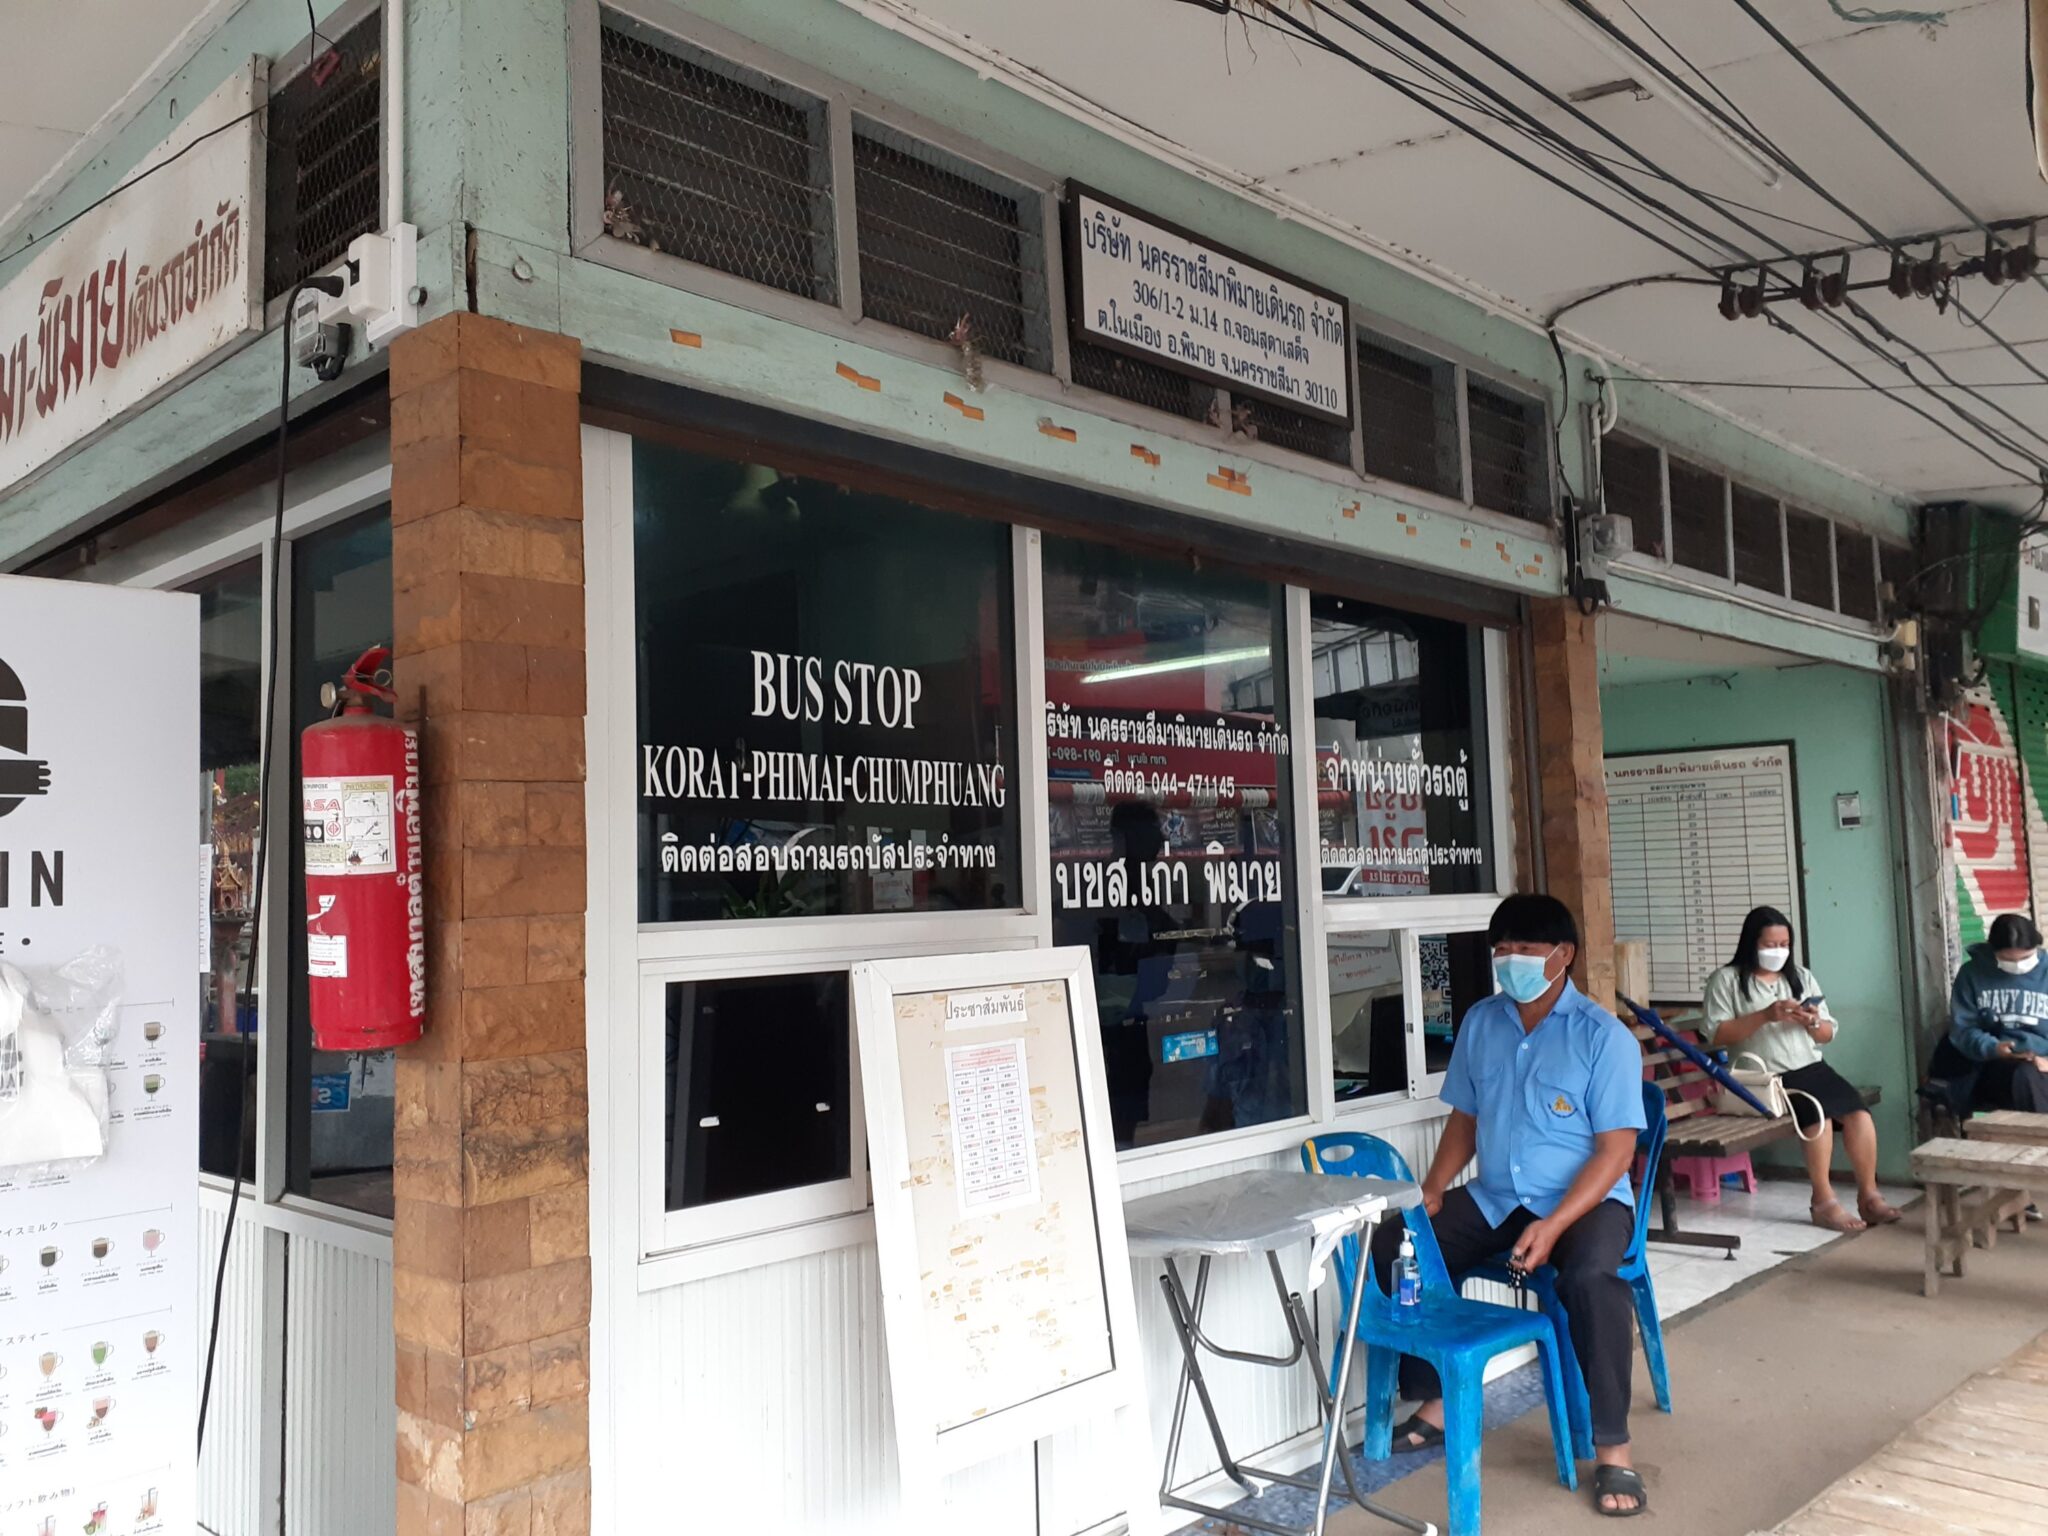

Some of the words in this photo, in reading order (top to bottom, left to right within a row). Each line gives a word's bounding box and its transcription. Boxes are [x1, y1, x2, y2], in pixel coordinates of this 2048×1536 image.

[1084, 211, 1132, 262] บริษัท
[1139, 240, 1305, 332] นครราชสีมาพิมายเดินรถ
[1311, 302, 1344, 346] จำกัด
[1132, 280, 1184, 320] 306/1-2
[1190, 304, 1218, 332] ม.14
[1098, 300, 1162, 348] ต.ในเมือง
[1168, 328, 1216, 368] อ.พิมาย
[1221, 352, 1300, 397] จ.นครราชสีมา
[1304, 380, 1338, 409] 30110
[751, 650, 824, 723] BUS
[834, 659, 922, 729] STOP
[1045, 700, 1082, 740] ริษัท
[1088, 710, 1254, 752] นครราชสีมาพิมายเดินรถ
[1257, 723, 1289, 755] จำกัด
[1104, 758, 1145, 794] ติดต่อ
[1152, 773, 1235, 798] 044-471145
[1326, 735, 1469, 810] จำหน่ายตั๋วรถตู้
[661, 833, 996, 873] ติดต่อสอบถามรถบัสประจำทาง
[1055, 841, 1188, 908] บขส.เก่า
[1204, 841, 1282, 904] พิมาย
[1321, 839, 1482, 874] ติดต่อสอบถามรถตู้ประจำทาง
[945, 992, 1024, 1020] ประชาสัมพันธ์
[1982, 988, 2020, 1013] NAVY
